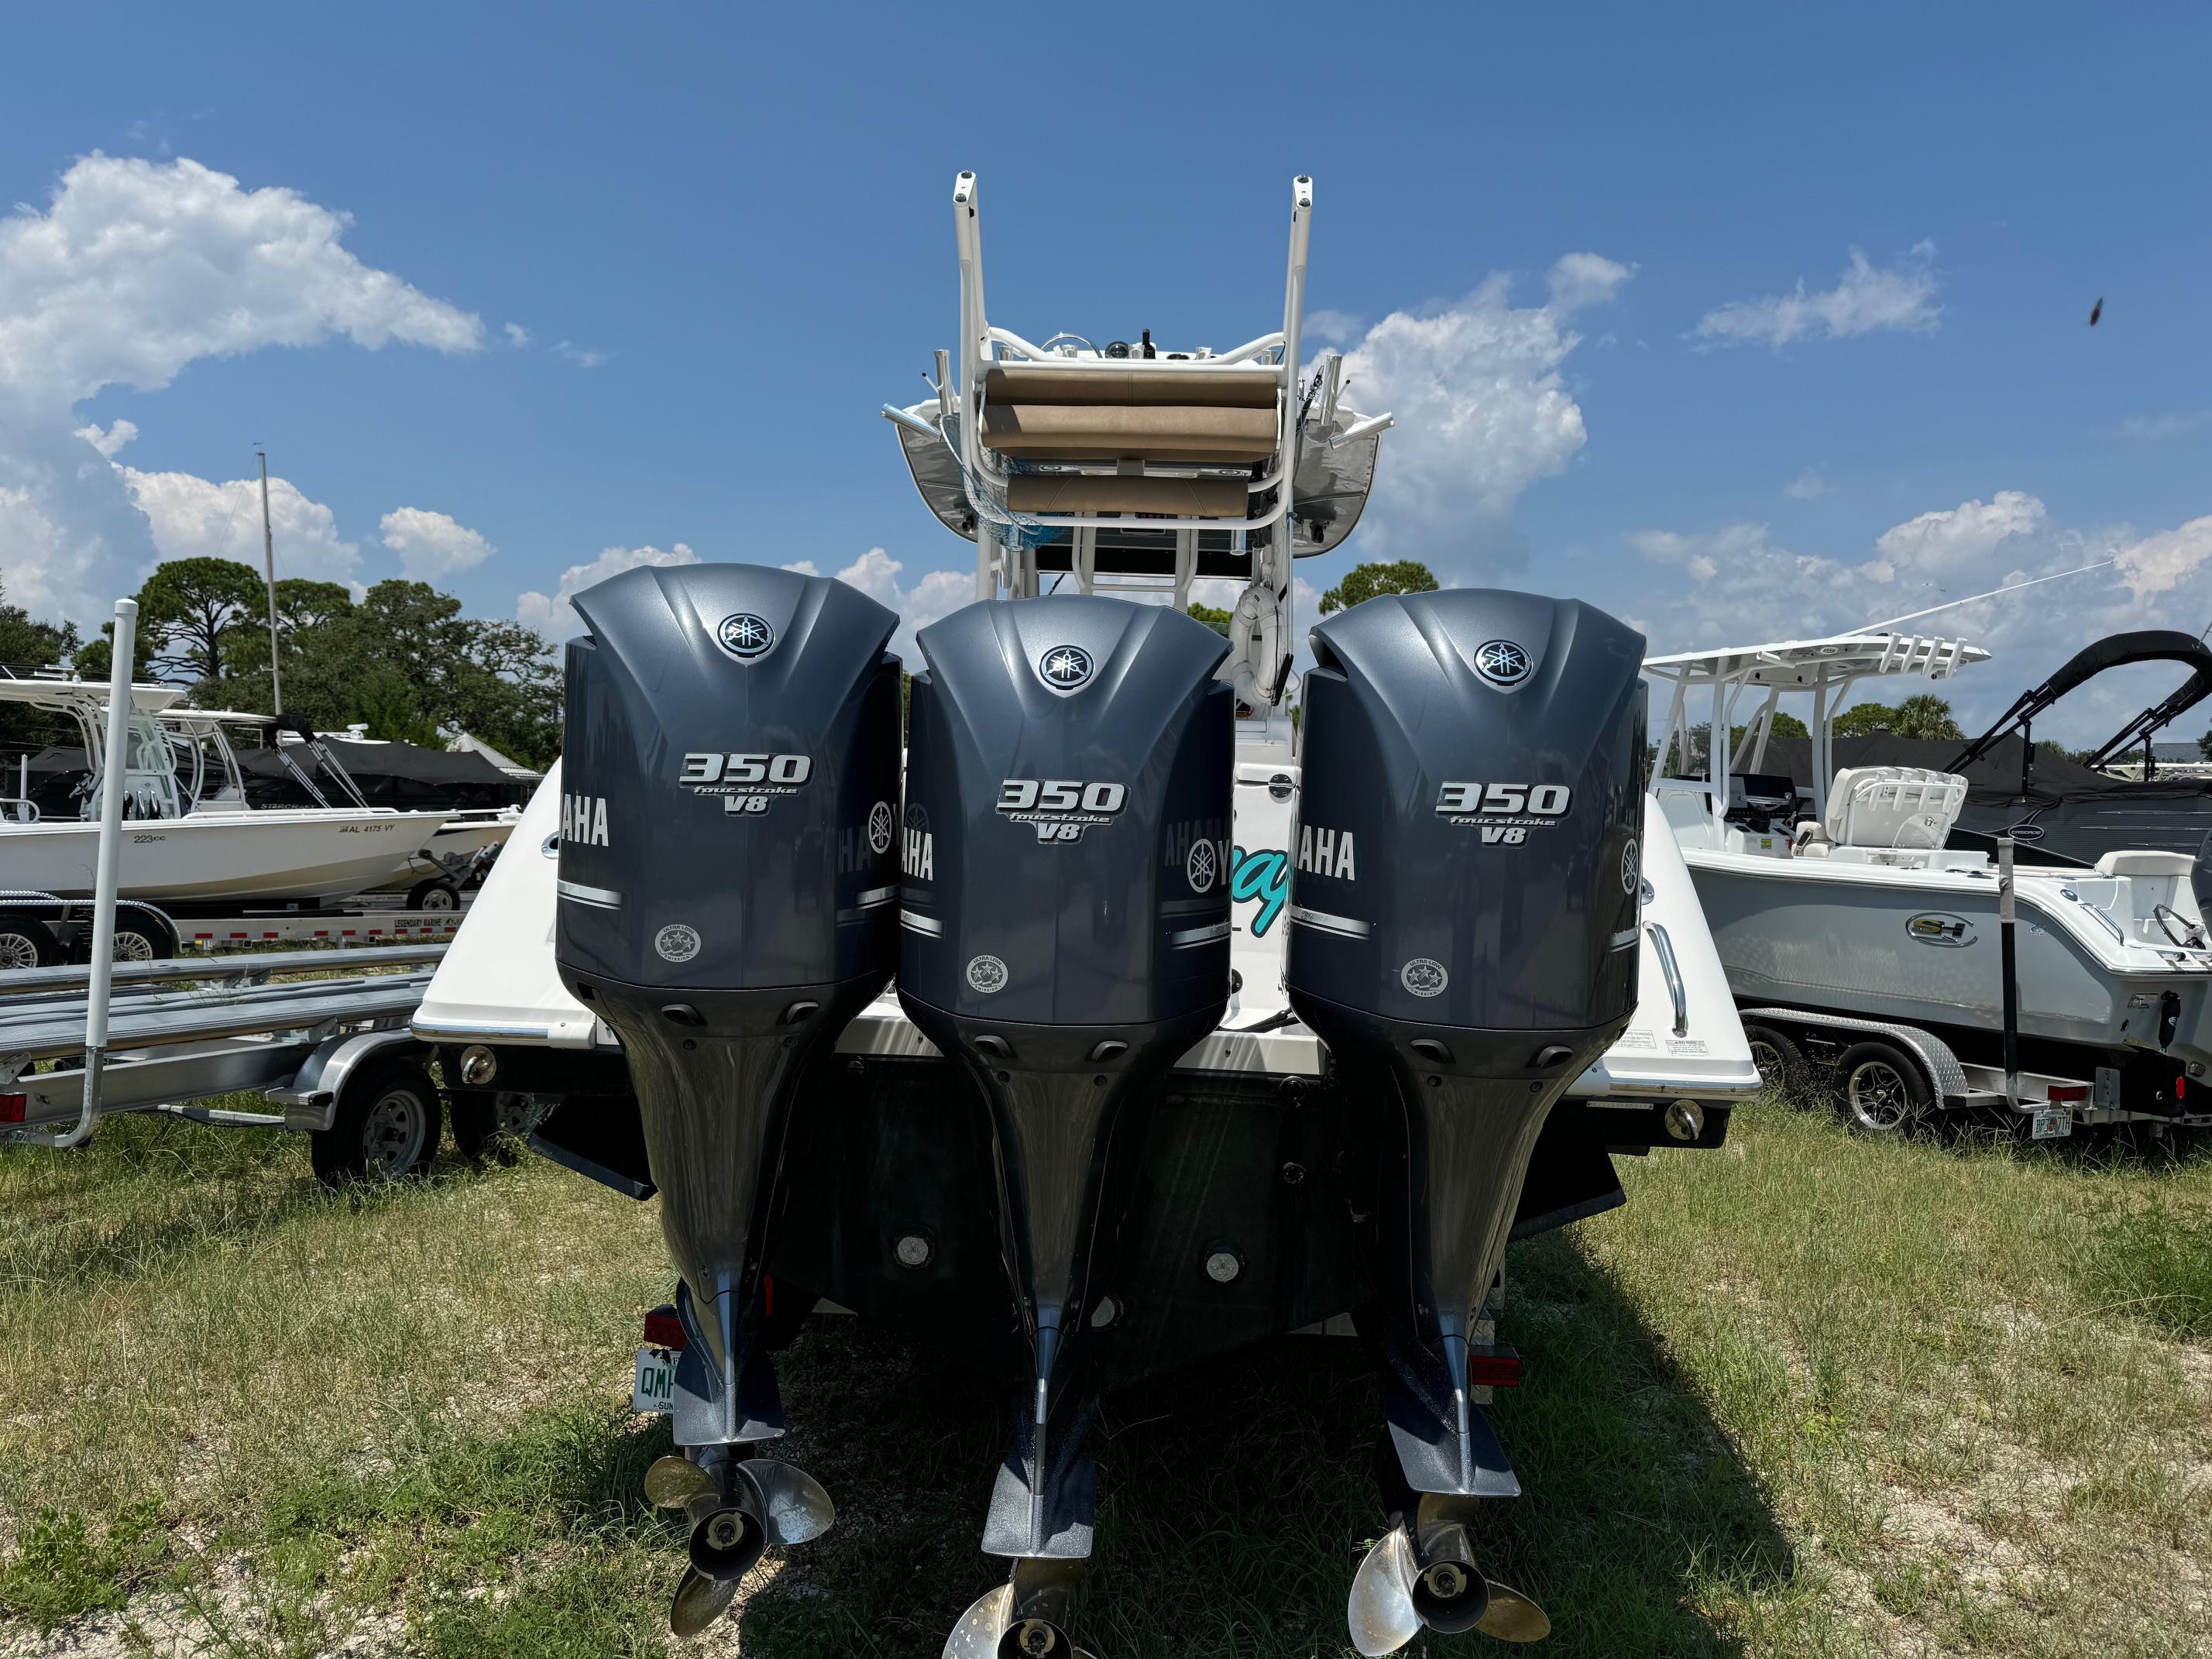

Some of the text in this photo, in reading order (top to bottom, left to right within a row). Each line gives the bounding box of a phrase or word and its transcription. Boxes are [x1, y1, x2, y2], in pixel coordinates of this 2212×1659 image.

[678, 754, 811, 783] 350
[724, 795, 768, 812] V8
[996, 779, 1125, 812] 350
[1435, 782, 1570, 815] 350
[1037, 823, 1080, 840] V8
[1482, 826, 1527, 844] V8
